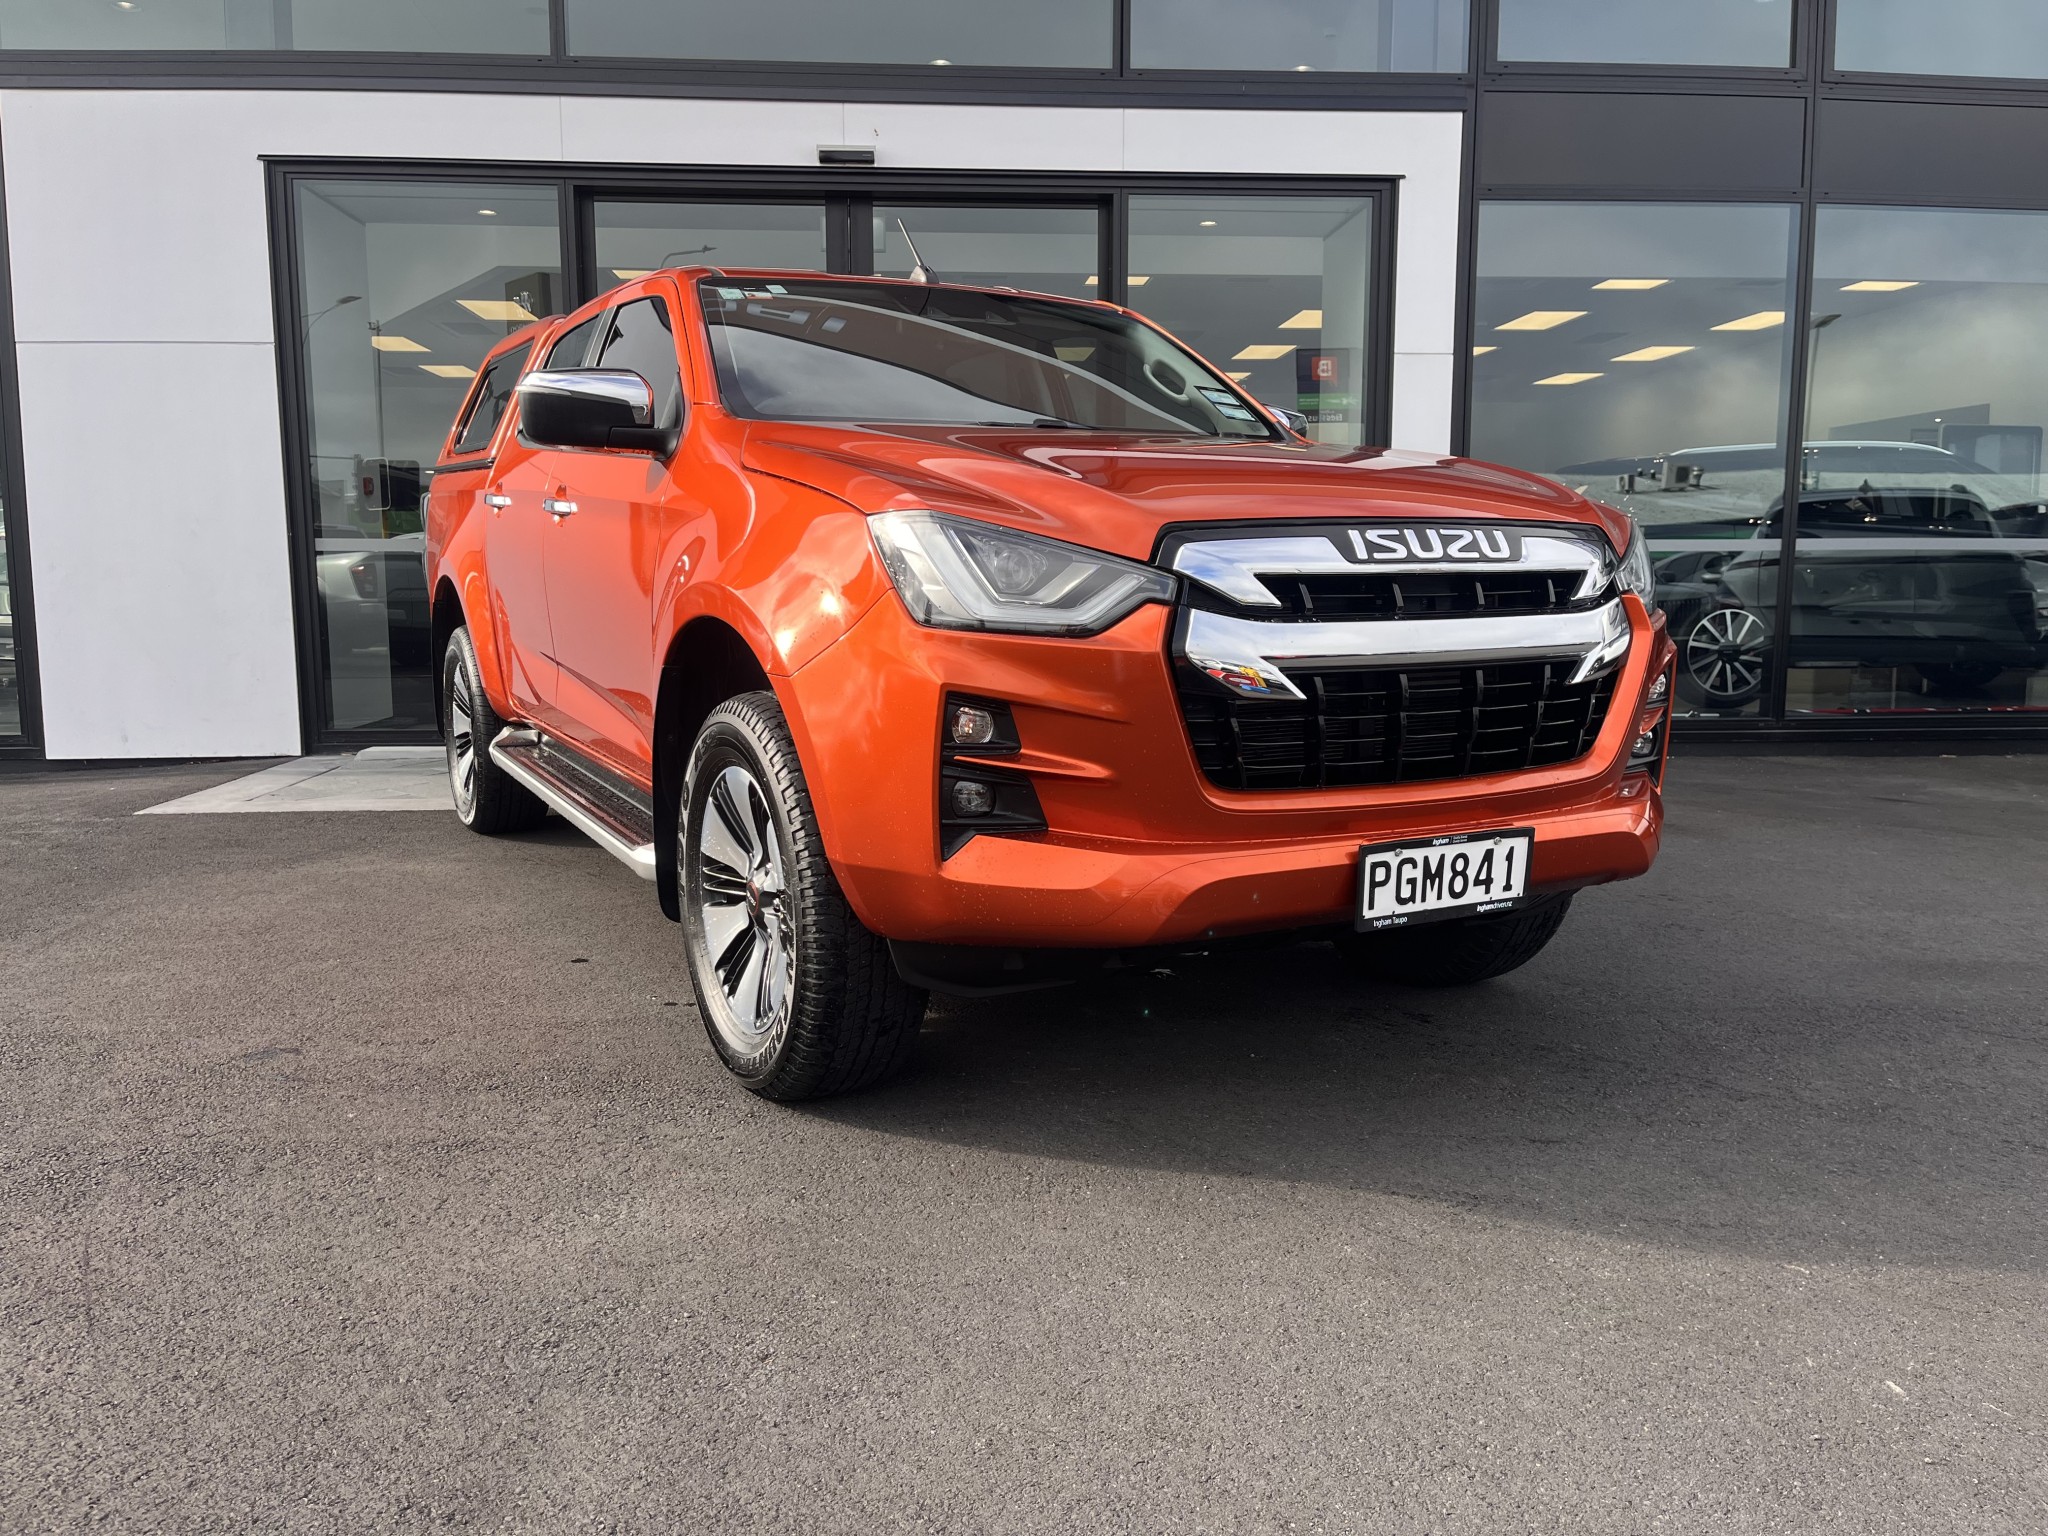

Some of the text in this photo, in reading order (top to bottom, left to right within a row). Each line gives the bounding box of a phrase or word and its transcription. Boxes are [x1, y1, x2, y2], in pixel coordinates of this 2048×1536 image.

[1348, 529, 1511, 559] ISUZU
[1368, 846, 1515, 911] PGM841
[1373, 916, 1408, 928] Ingham Taupo
